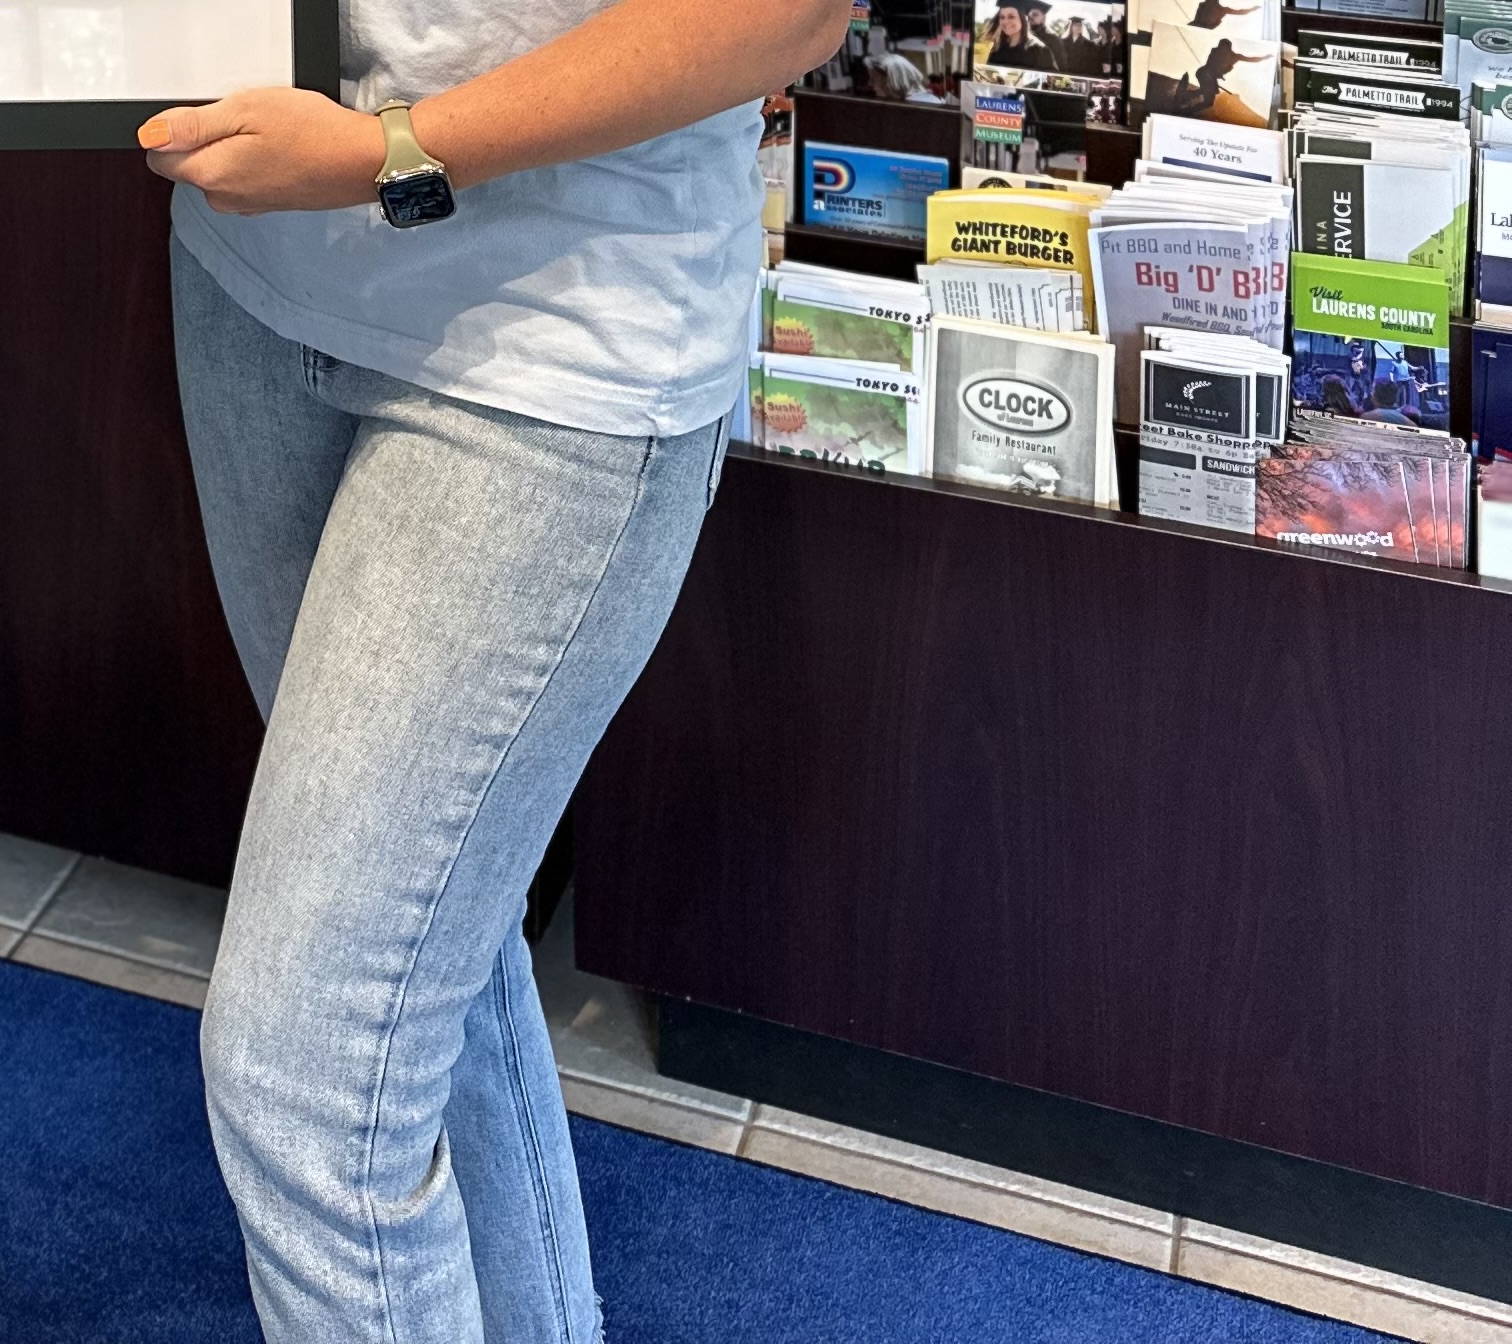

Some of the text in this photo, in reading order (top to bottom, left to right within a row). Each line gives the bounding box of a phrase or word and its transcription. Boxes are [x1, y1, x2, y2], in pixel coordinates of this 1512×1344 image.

[1331, 48, 1376, 64] PALMETTO
[976, 98, 1022, 112] LAURENS
[1345, 87, 1392, 103] PALMETTO
[1394, 92, 1419, 106] TRAIL
[1430, 98, 1454, 109] 1994
[975, 113, 1022, 127] COUNTY
[975, 128, 1022, 143] MUSEUM
[1192, 146, 1243, 164] 40 Years
[955, 220, 1070, 248] WHITEFORD'S
[950, 235, 1075, 266] GIANT BURGER
[1101, 238, 1241, 261] Pit BBQ and Home
[1135, 262, 1179, 294] Big
[1309, 285, 1344, 301] Visit
[869, 306, 912, 323] TOKYO
[1172, 296, 1249, 322] DINE IN AND
[1312, 298, 1437, 329] LAURENS COUNTY
[775, 325, 809, 338] Sushi
[855, 377, 900, 393] TOKYO
[767, 400, 801, 413] Sushi
[978, 387, 1054, 420] CLOCK
[1165, 402, 1230, 418] MAIN STREET
[971, 429, 1057, 456] Family Restaurant
[1167, 427, 1203, 441] Bake
